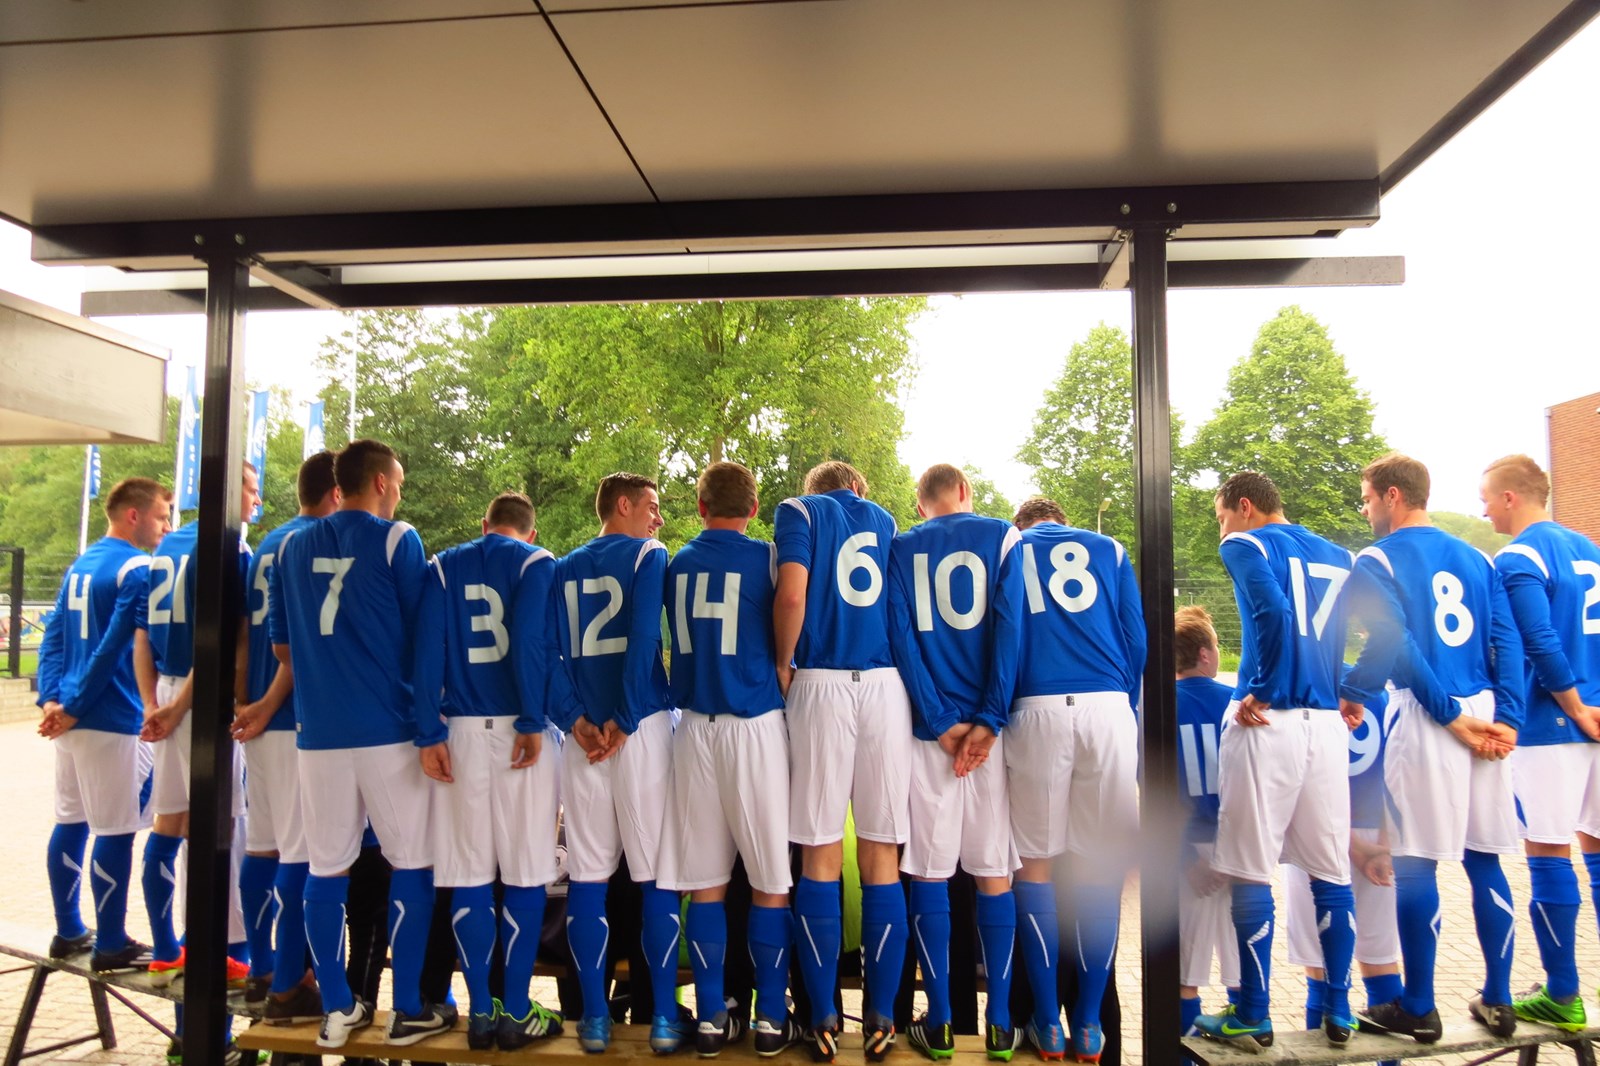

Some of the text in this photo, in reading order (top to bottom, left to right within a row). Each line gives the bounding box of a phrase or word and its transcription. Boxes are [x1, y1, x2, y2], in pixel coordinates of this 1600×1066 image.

[68, 573, 92, 640] 4
[147, 554, 190, 625] 21
[252, 553, 275, 625] 5
[312, 557, 354, 636] 7
[836, 531, 883, 607] 6
[913, 551, 987, 632] 10
[1022, 541, 1098, 614] 18
[1289, 556, 1351, 641] 17
[1570, 559, 1600, 635] 2
[464, 583, 510, 664] 3
[564, 575, 628, 658] 12
[675, 572, 742, 656] 14
[1431, 571, 1475, 648] 8
[1179, 723, 1218, 797] 11
[1348, 707, 1382, 777] 9
